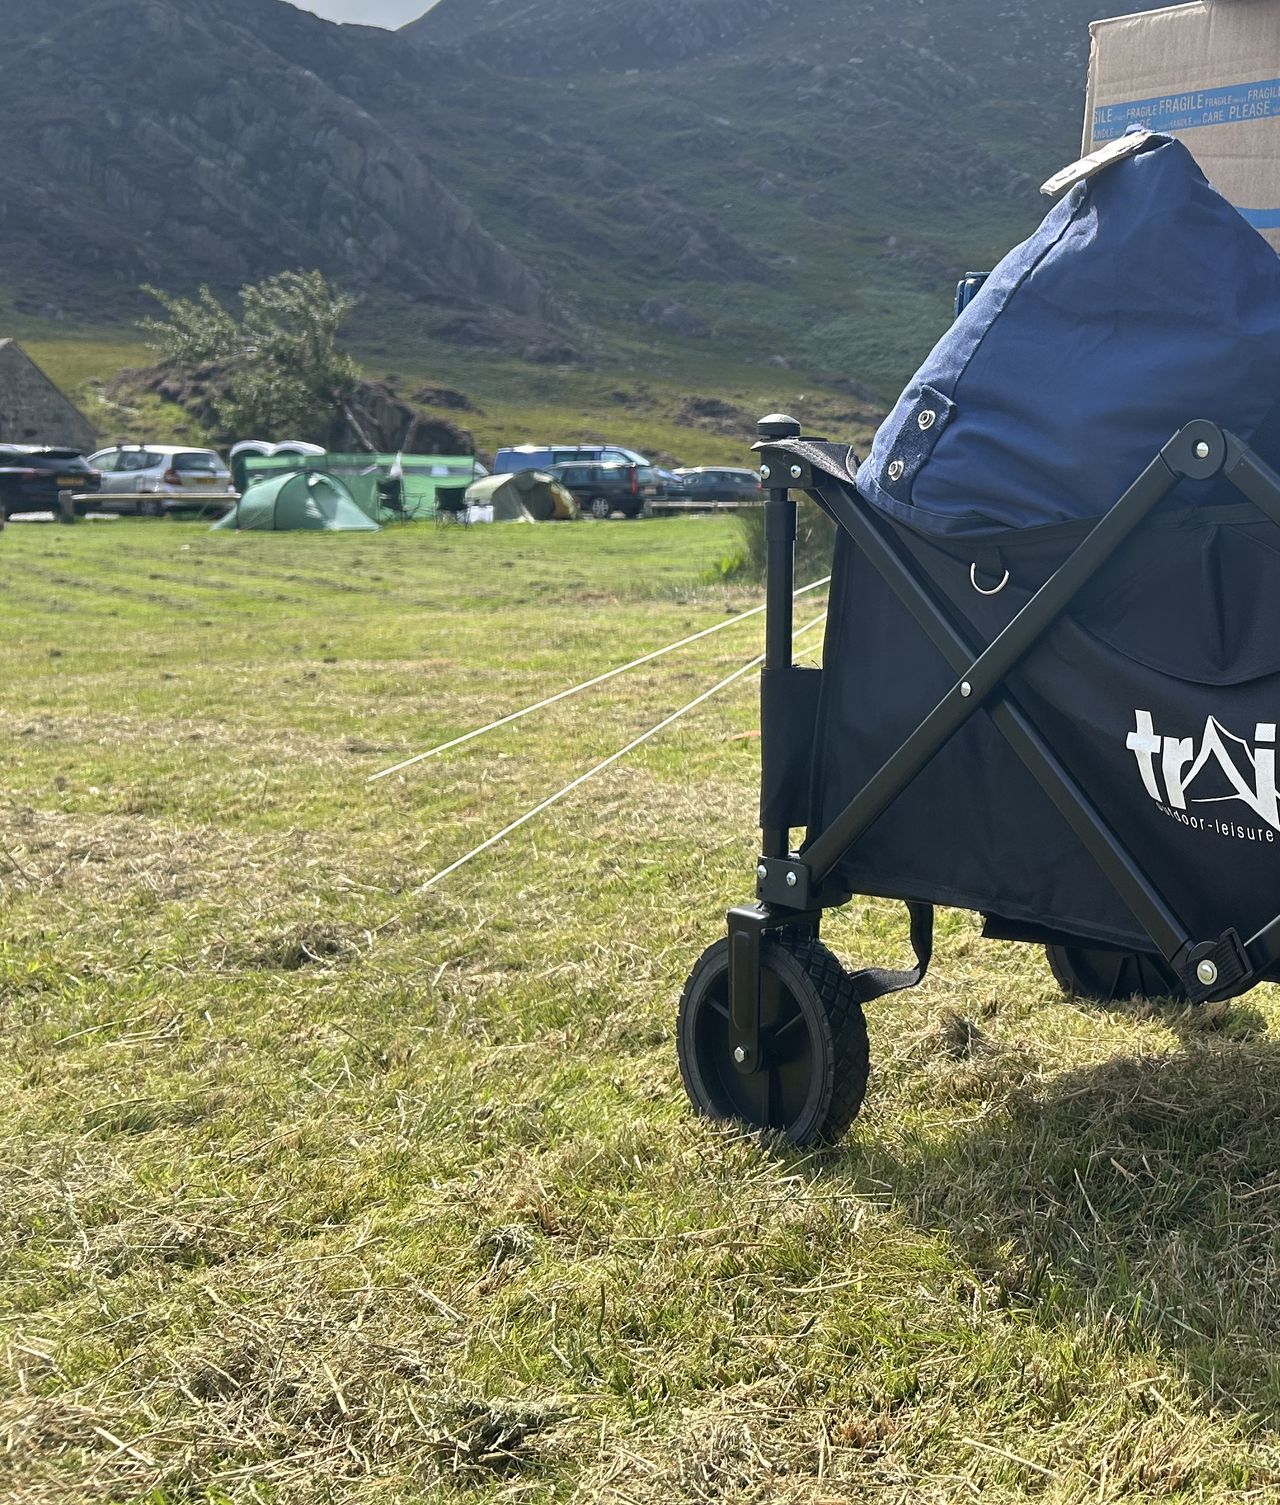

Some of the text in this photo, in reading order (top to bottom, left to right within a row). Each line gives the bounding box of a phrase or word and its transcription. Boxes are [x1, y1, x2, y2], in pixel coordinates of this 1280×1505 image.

[1126, 104, 1158, 120] FRAGILE
[1159, 94, 1204, 115] FRAGILE
[1205, 95, 1232, 108] FRAGILE
[1202, 110, 1224, 124] CARE
[1229, 101, 1271, 120] PLEASE
